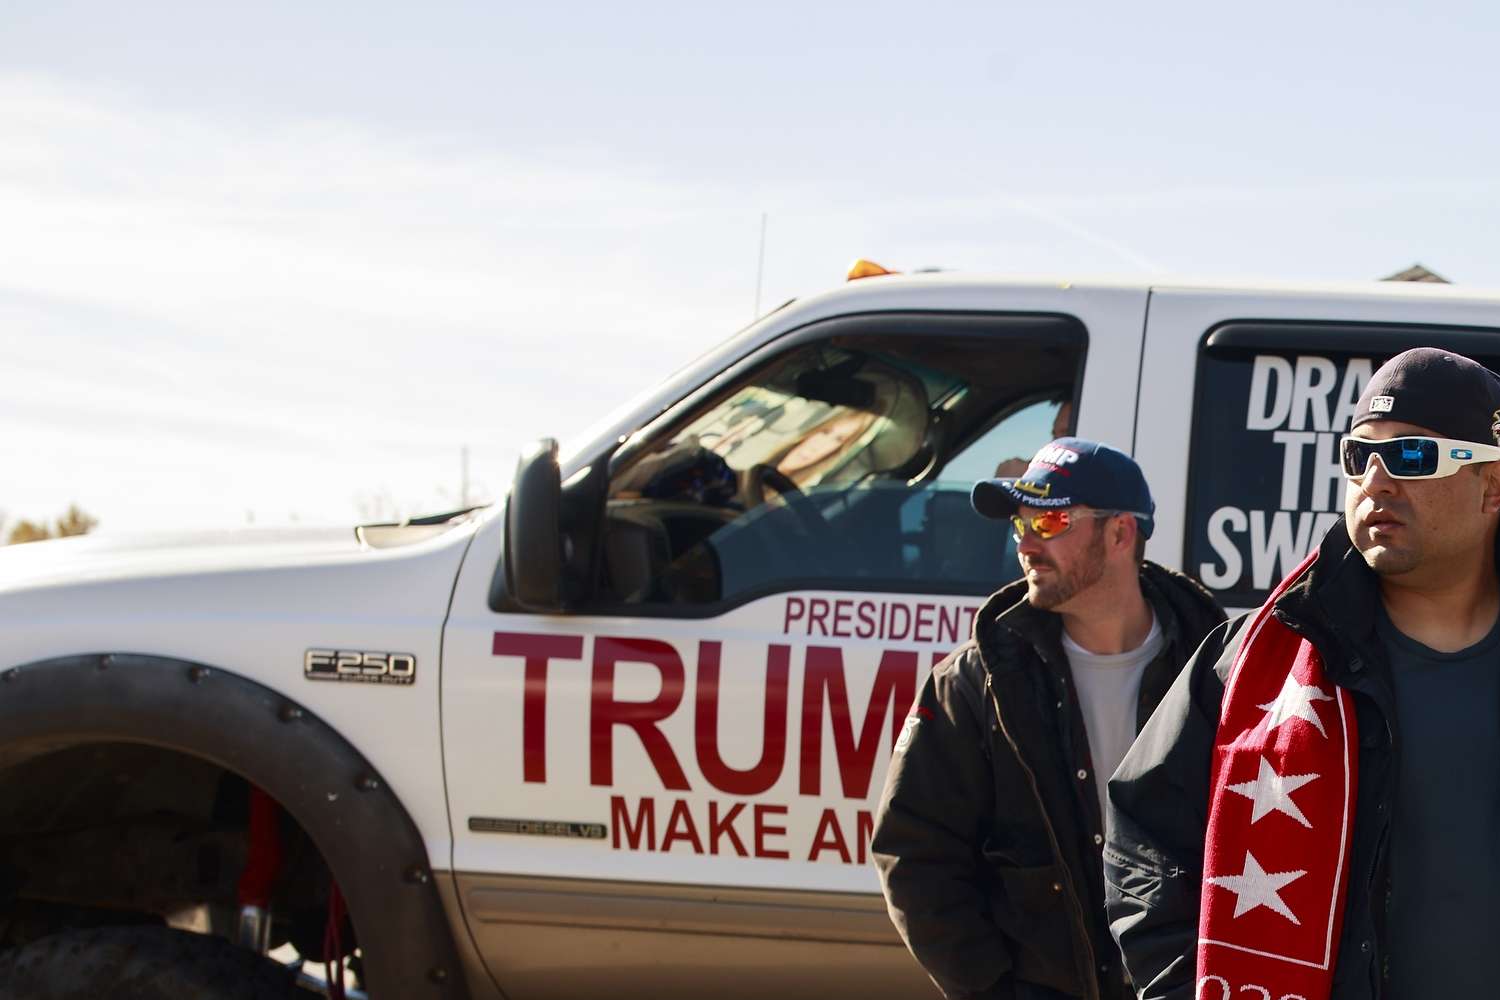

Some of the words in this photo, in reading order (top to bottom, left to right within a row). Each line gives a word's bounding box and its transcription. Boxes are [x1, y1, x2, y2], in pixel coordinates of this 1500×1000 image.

[784, 598, 979, 642] PRESIDENT
[492, 632, 950, 799] TRUM
[610, 796, 790, 859] MAKE
